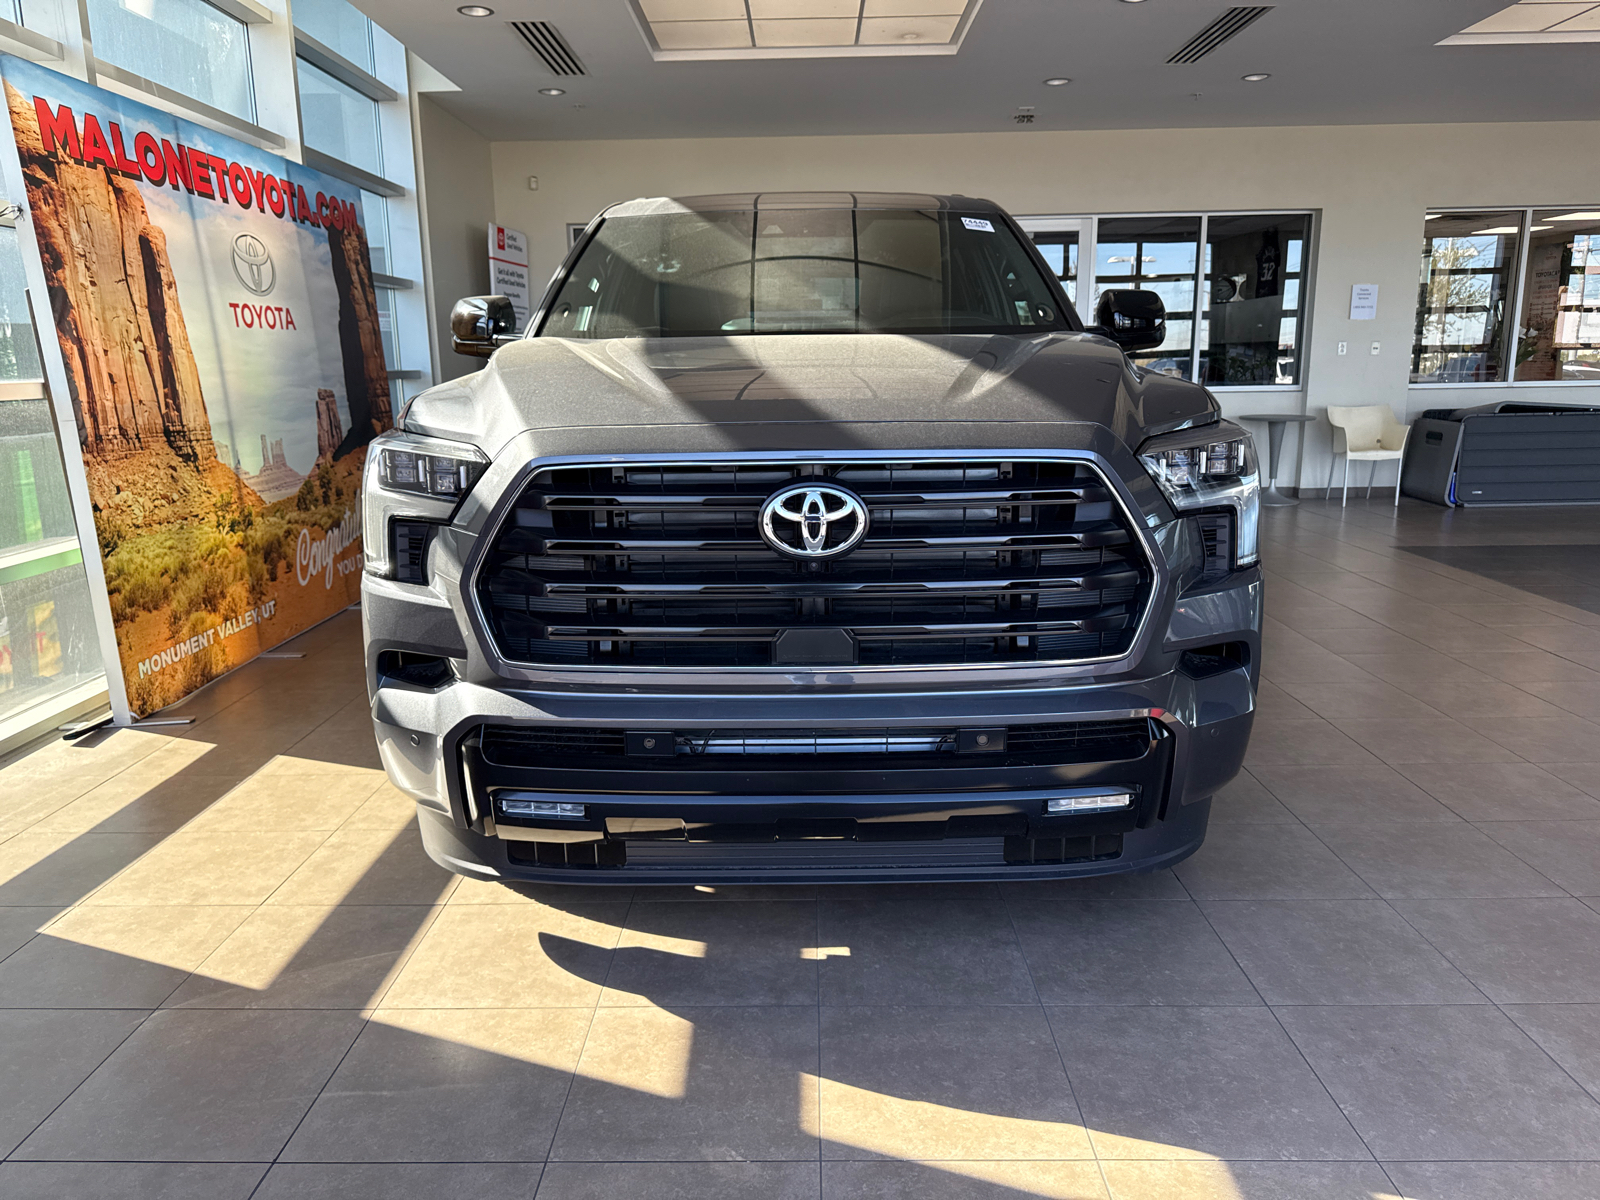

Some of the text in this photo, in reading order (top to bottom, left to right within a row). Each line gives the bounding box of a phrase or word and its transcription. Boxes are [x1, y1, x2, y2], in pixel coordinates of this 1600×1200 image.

[33, 95, 359, 236] MALONETOYOTA.COM
[229, 302, 297, 331] TOYOTA
[337, 555, 356, 577] YOU
[138, 600, 276, 679] MONUMENT VALLEY, UT
